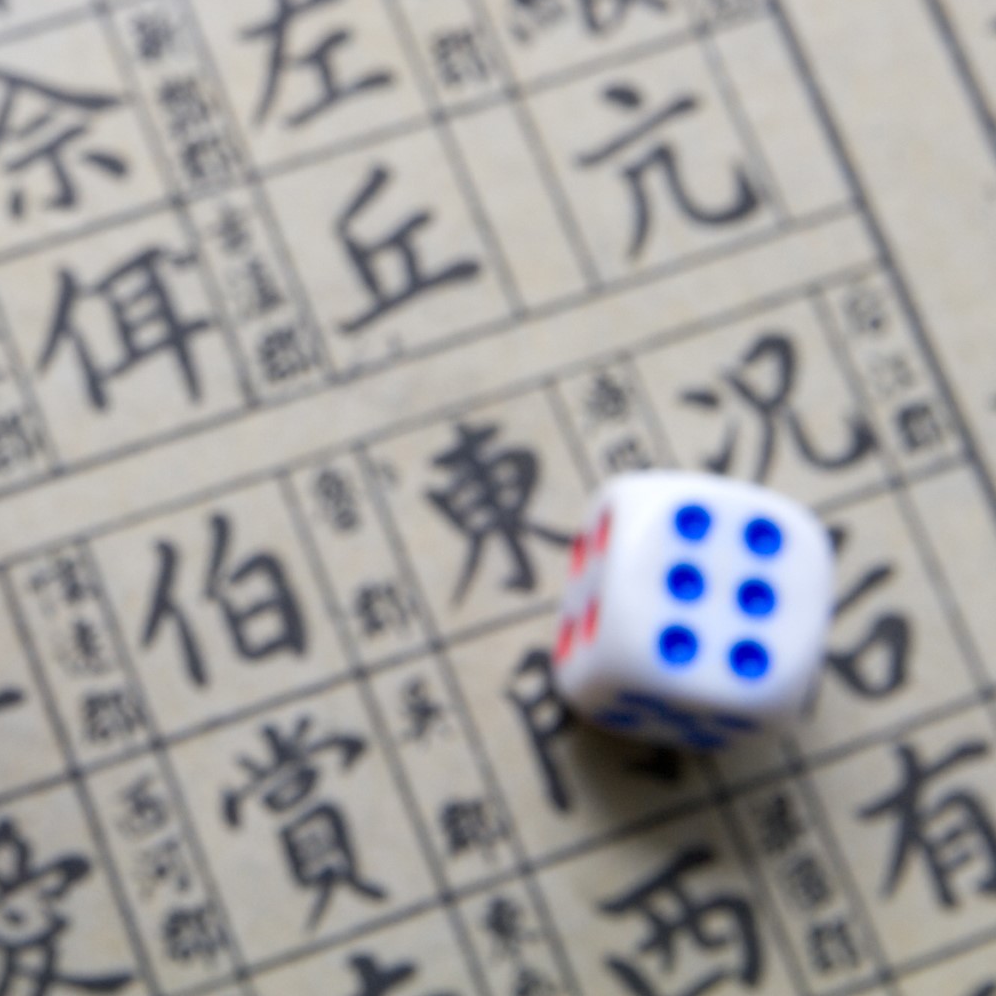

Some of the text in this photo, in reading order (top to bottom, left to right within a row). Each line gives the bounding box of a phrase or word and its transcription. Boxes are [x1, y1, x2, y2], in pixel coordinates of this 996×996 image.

[338, 162, 484, 338] 丘
[574, 80, 764, 266] 亢
[140, 512, 308, 689] 伯
[424, 419, 576, 610] 東
[219, 712, 390, 935] 賞
[854, 740, 996, 914] 有
